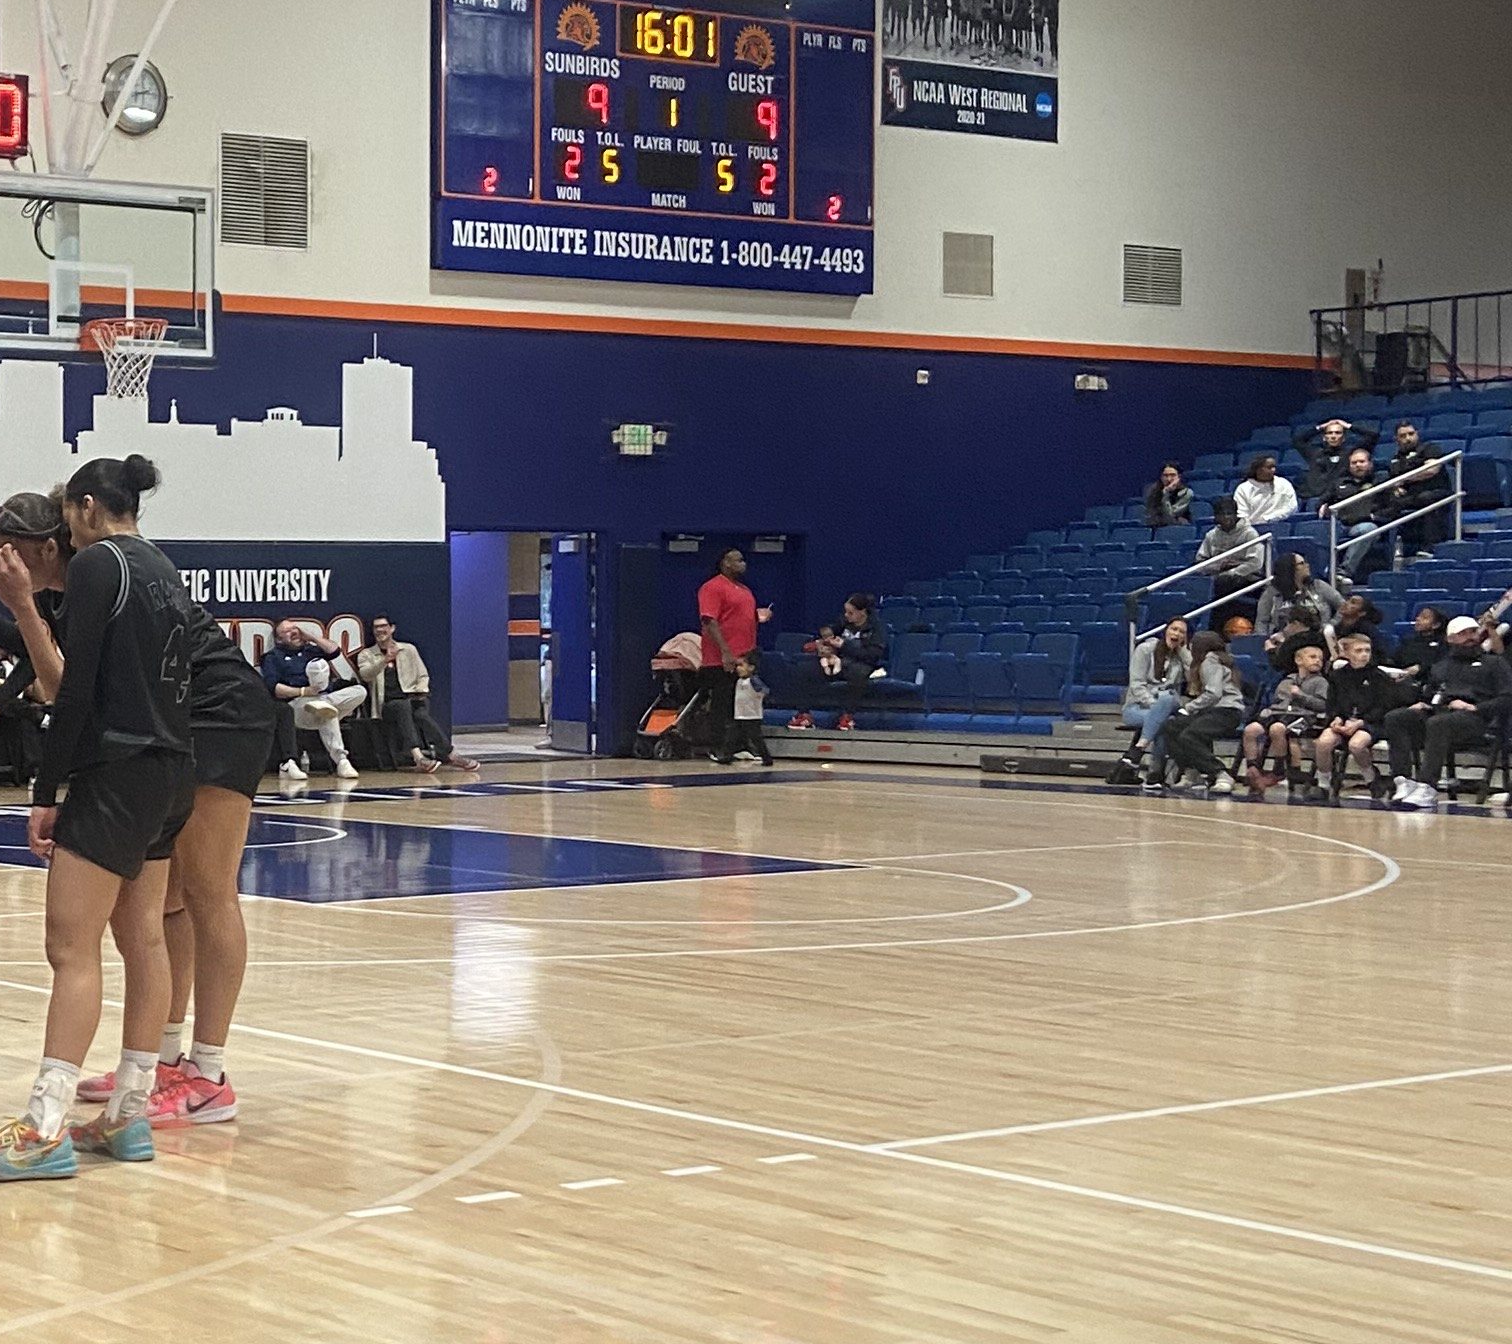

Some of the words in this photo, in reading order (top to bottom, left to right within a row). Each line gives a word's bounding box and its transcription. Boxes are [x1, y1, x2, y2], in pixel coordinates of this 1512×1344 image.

[636, 10, 716, 58] 16:01
[544, 51, 621, 79] SUNBIRDS
[649, 75, 686, 92] PERIOD
[728, 72, 775, 94] GUEST
[913, 80, 945, 104] NCAA
[586, 83, 609, 124] 9
[669, 98, 677, 127] 1
[756, 101, 778, 140] 9
[551, 127, 585, 144] FOULS
[596, 132, 625, 147] T.O.L.
[634, 135, 672, 152] PLAYER
[676, 138, 702, 154] FOUL
[711, 142, 738, 157] T.O.L.
[747, 145, 779, 161] FOULS
[564, 146, 581, 179] 2
[602, 149, 619, 183] 5
[483, 167, 498, 193] 2
[717, 159, 734, 192] 5
[760, 163, 777, 195] 2
[556, 186, 581, 201] WON
[651, 193, 686, 208] MATCH
[752, 202, 776, 216] WON
[827, 197, 841, 220] 2
[452, 219, 587, 256] MENNONITE
[593, 230, 713, 264] INSURANCE
[720, 240, 865, 274] 1-800-447-4493
[215, 568, 331, 603] UNIVERSITY
